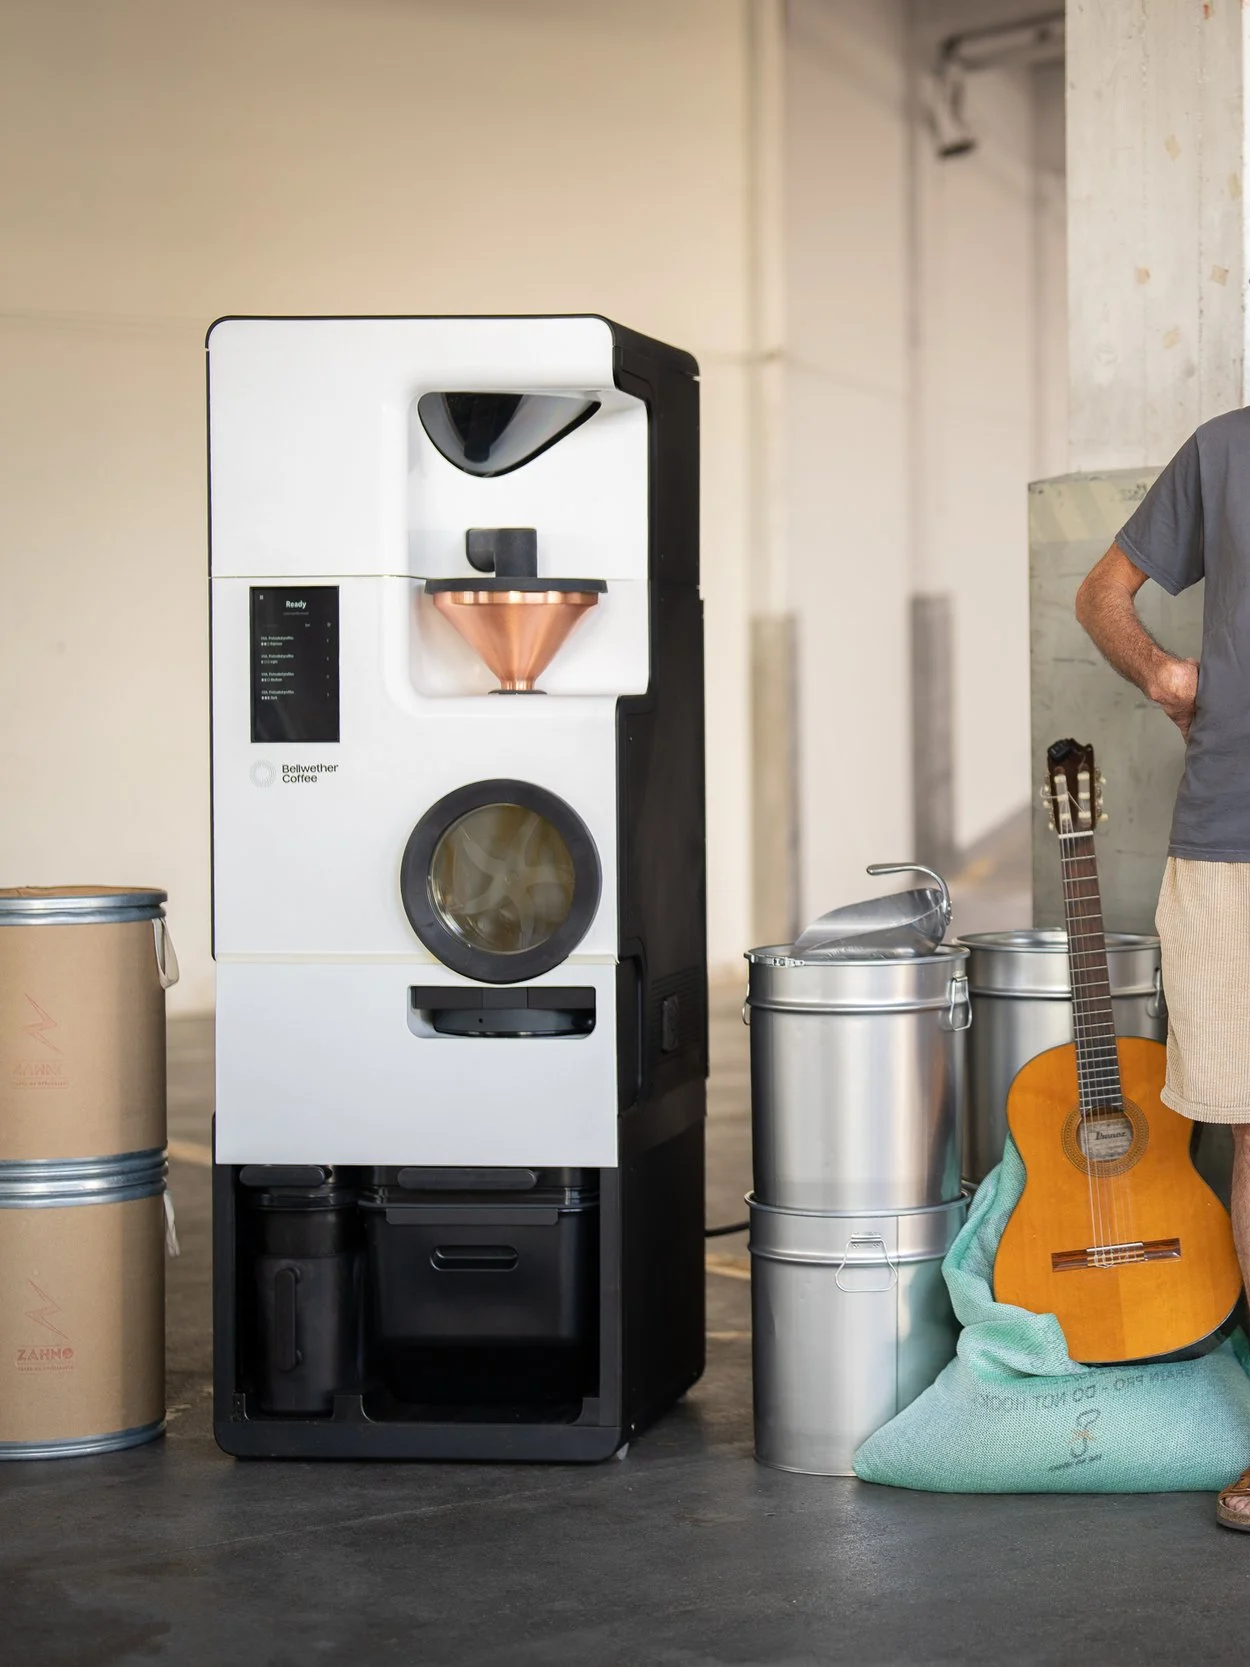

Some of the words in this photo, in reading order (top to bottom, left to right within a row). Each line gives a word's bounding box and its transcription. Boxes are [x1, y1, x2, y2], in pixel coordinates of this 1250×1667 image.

[285, 600, 307, 610] Ready
[282, 763, 338, 774] Bellwether
[282, 774, 318, 784] Coffee
[17, 1347, 74, 1361] ZAHNO
